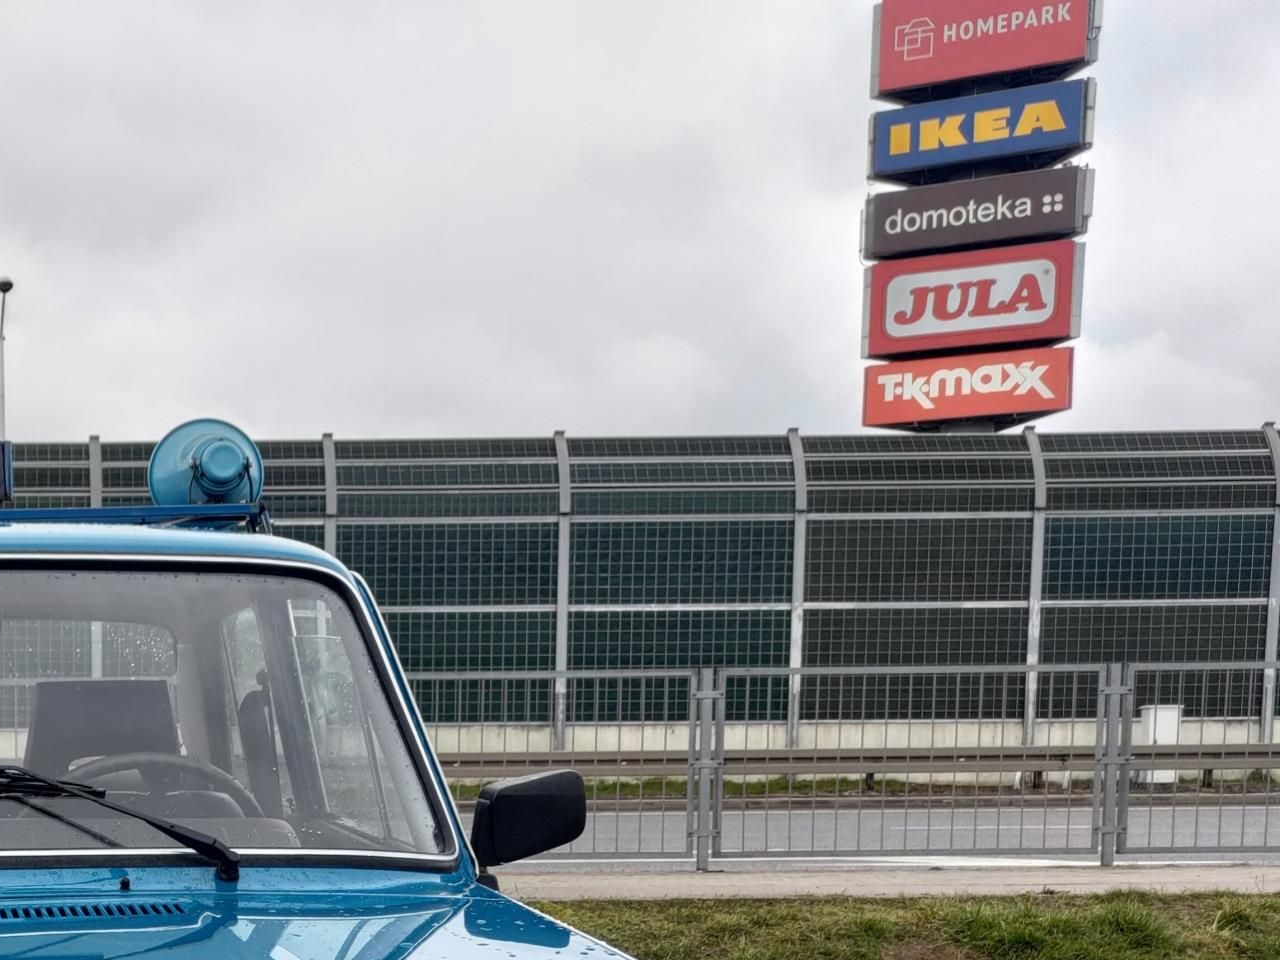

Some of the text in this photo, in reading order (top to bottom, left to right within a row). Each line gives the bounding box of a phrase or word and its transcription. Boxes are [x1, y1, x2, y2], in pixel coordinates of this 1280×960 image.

[943, 2, 1071, 43] HOMEPARK
[889, 100, 1067, 156] IKEA
[885, 195, 1032, 235] domoteka
[893, 273, 1048, 325] JULA
